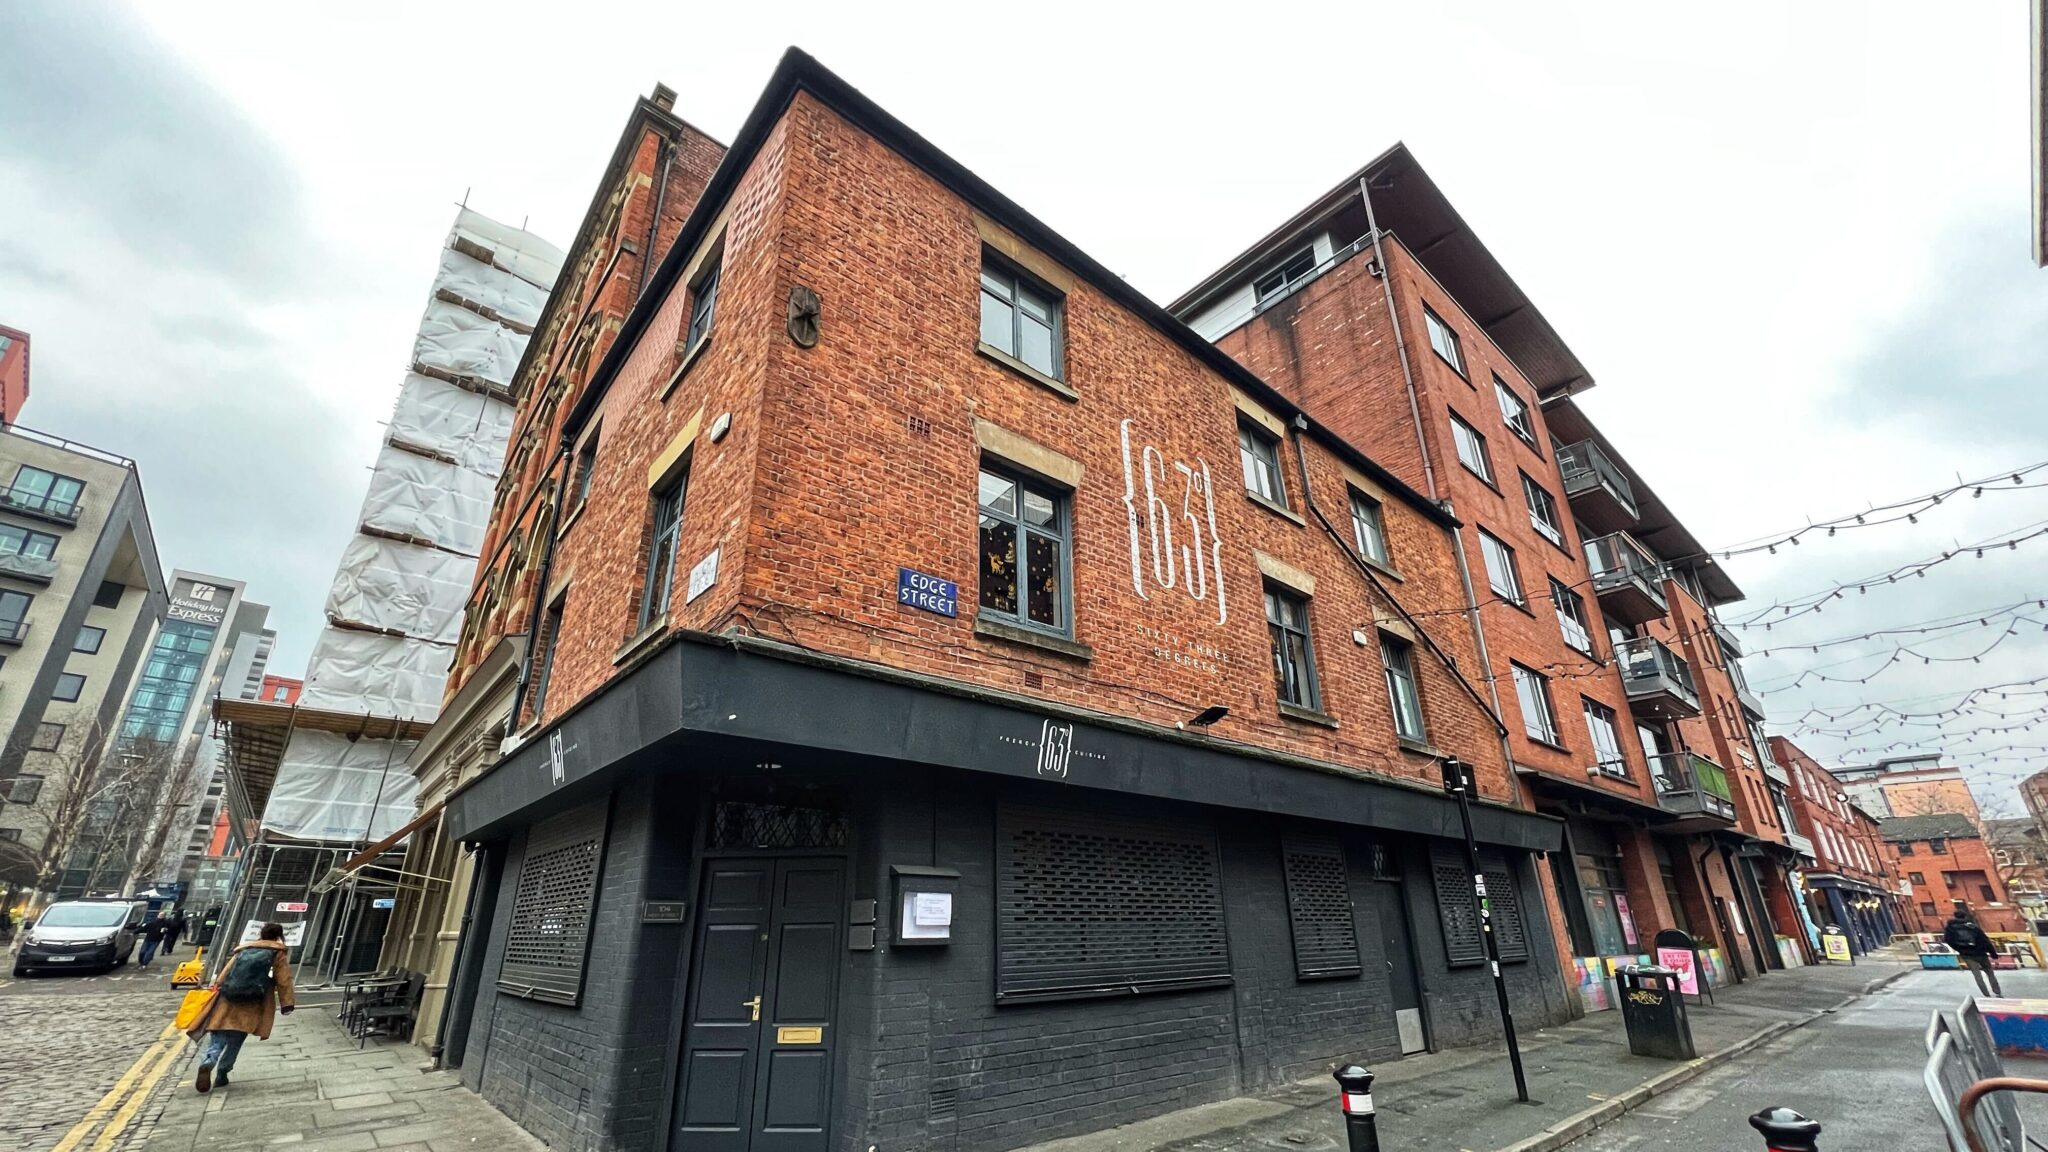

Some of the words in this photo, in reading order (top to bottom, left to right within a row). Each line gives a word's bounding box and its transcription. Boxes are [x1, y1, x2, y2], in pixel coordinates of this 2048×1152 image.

[910, 574, 947, 597] EDGE
[171, 597, 209, 612] Holiday
[209, 604, 224, 614] Inn
[901, 588, 954, 614] STREET
[168, 605, 221, 623] Express
[1136, 624, 1178, 646] SIXTY
[1187, 641, 1229, 663] THREE
[1154, 646, 1217, 674] DEGREES
